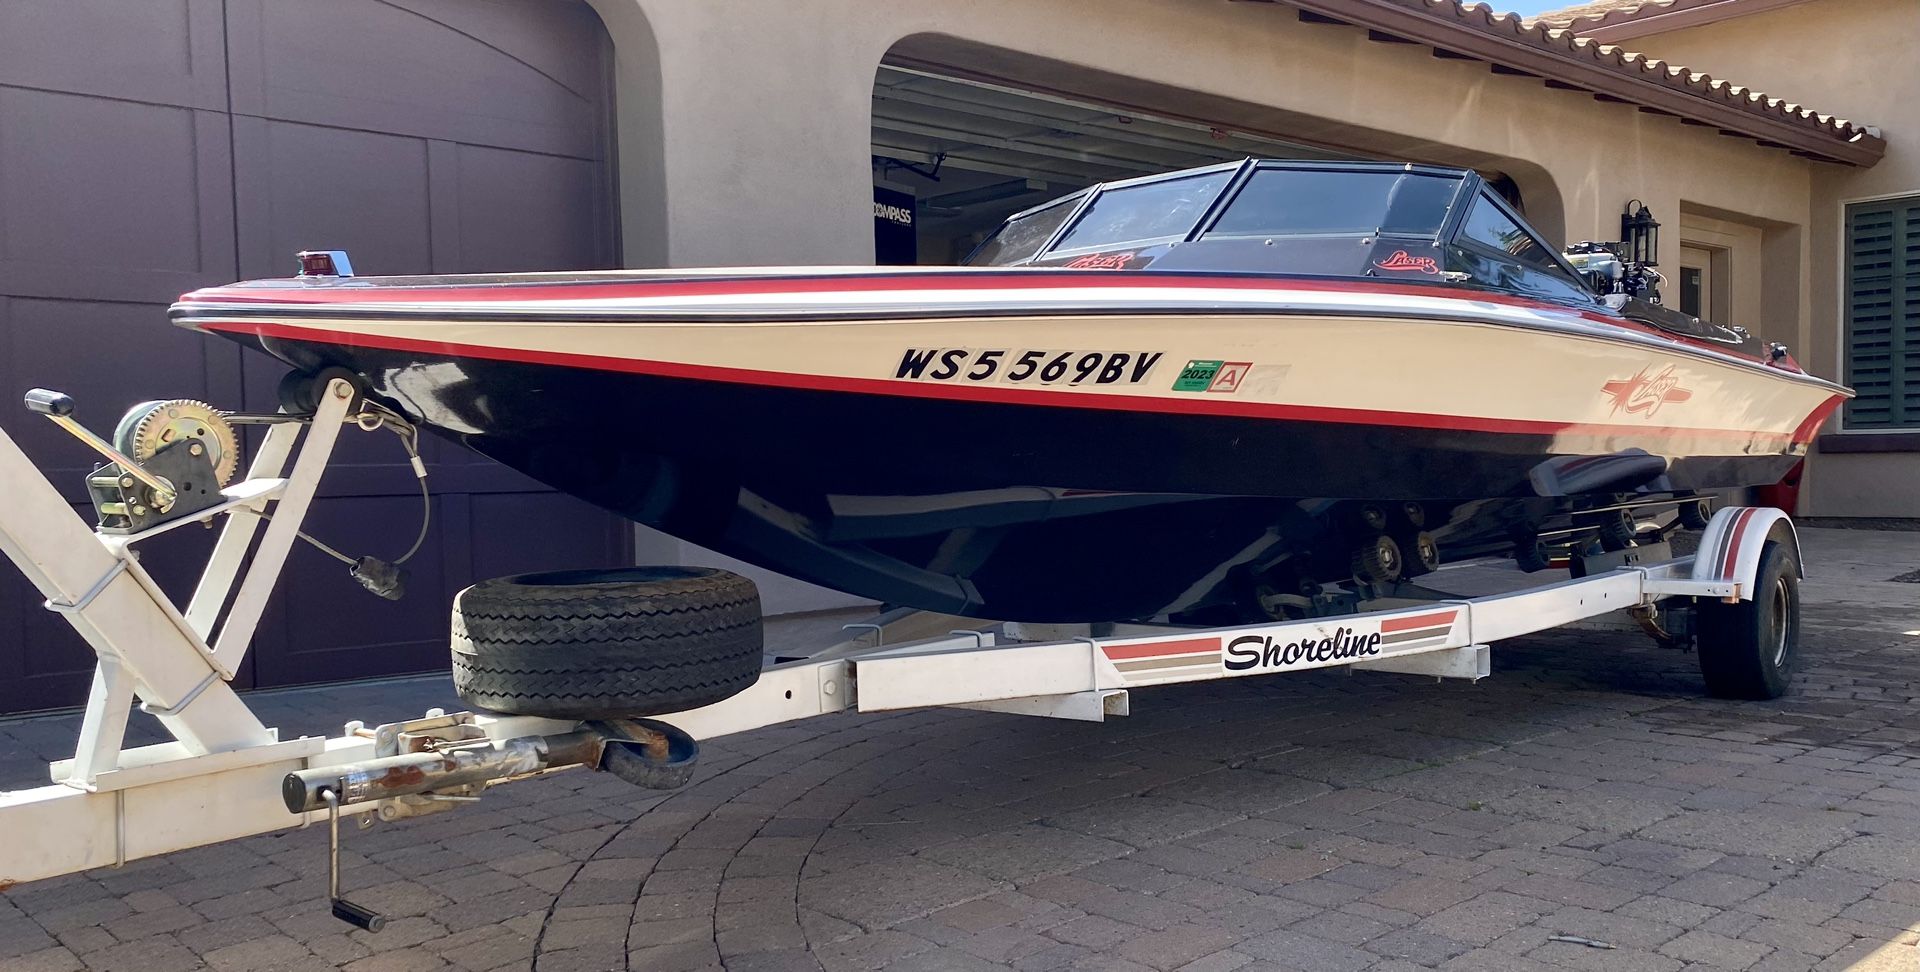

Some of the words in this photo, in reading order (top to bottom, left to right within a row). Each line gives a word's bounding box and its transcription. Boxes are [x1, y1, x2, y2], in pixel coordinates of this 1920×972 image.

[1181, 369, 1215, 380] 2023
[1216, 369, 1237, 386] A
[1224, 626, 1381, 670] Shoreline
